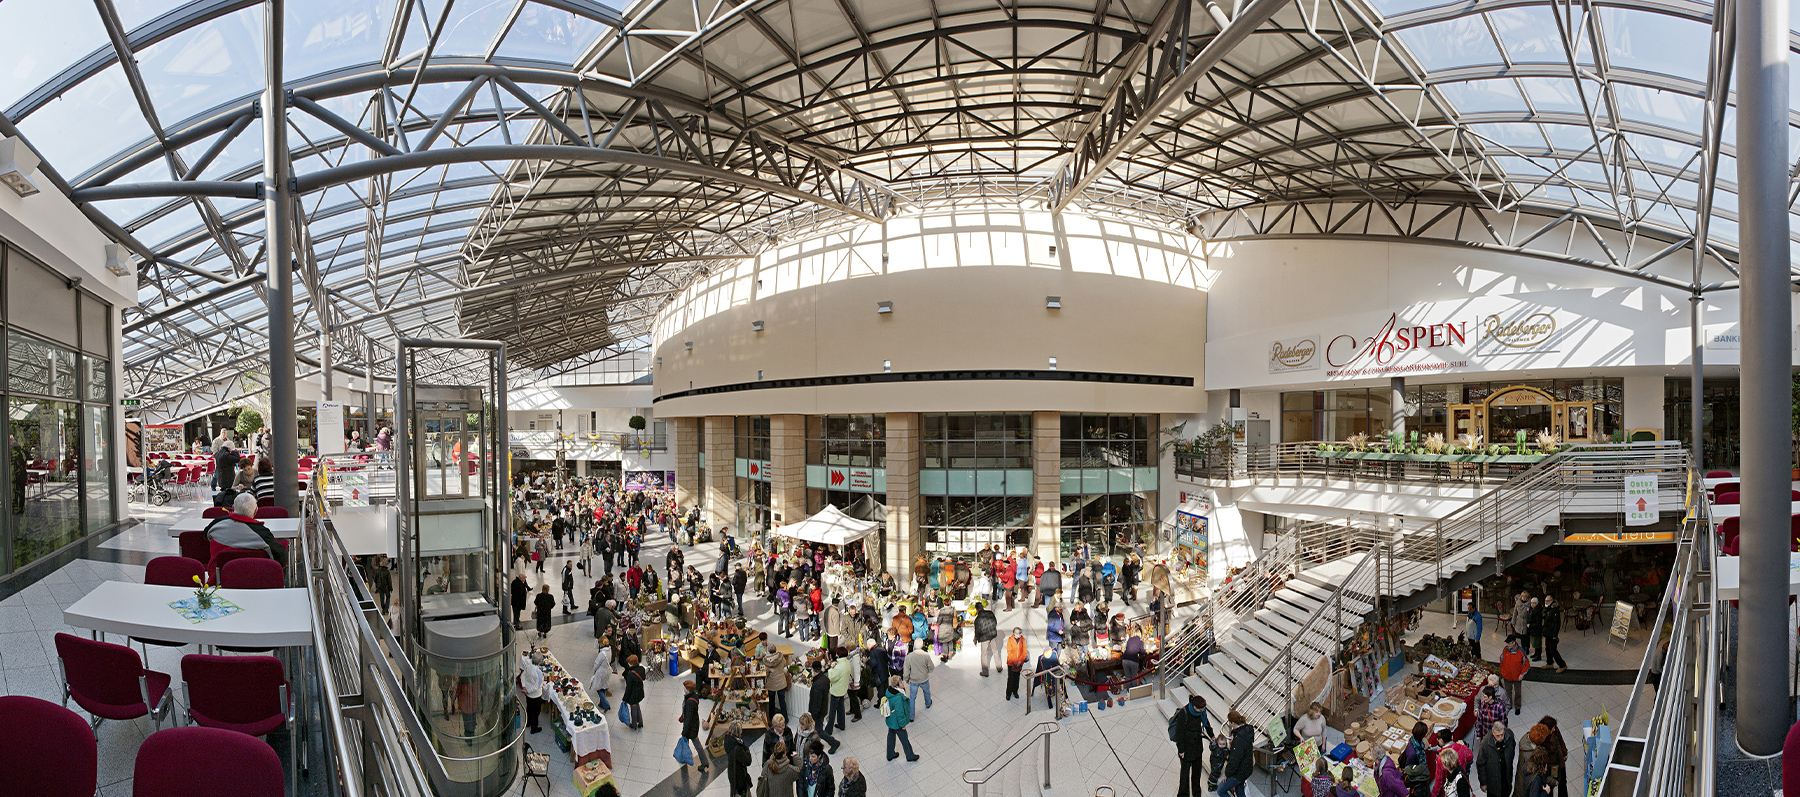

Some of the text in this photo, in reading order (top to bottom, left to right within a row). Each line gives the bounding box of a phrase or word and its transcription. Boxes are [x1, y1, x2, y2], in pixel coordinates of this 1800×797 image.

[1326, 312, 1468, 367] ASPEN
[1483, 313, 1554, 343] Radeberger
[1272, 340, 1315, 364] Radeberger
[1629, 487, 1655, 495] markt
[1630, 480, 1653, 488] Oster
